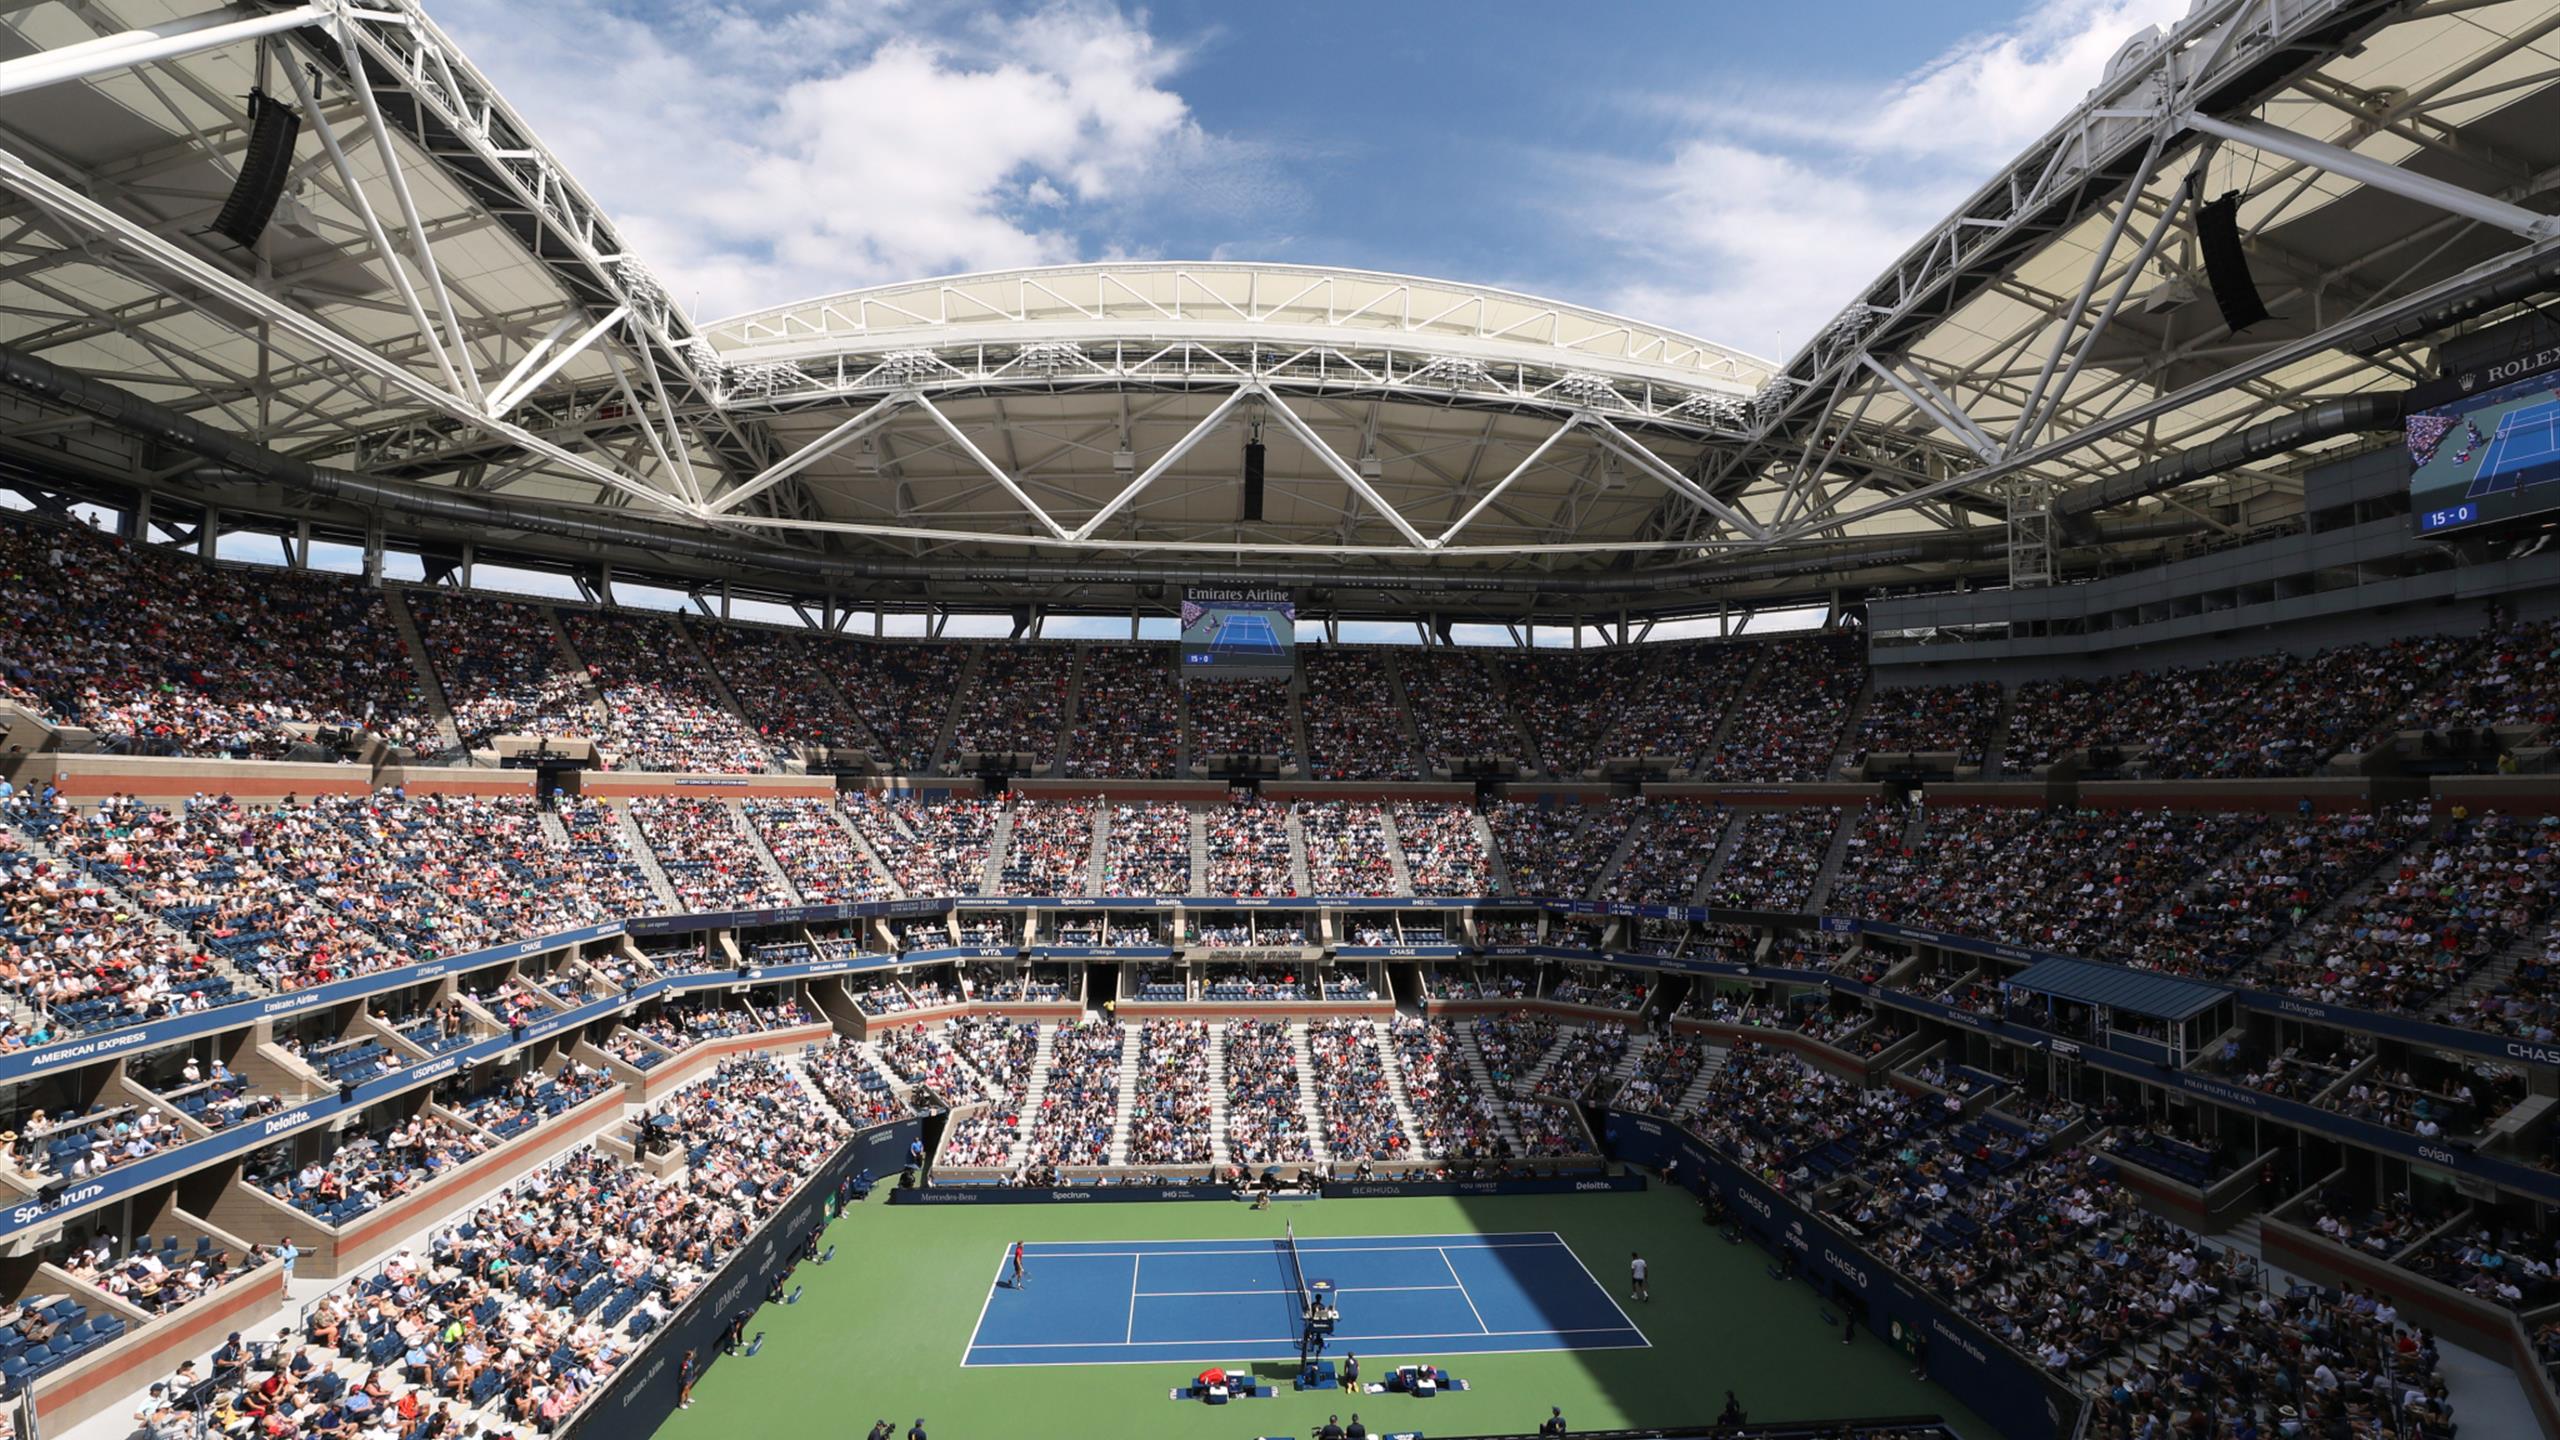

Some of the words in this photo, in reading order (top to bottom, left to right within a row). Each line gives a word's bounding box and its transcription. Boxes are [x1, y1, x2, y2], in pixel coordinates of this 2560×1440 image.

[2432, 511, 2446, 526] 15
[2458, 506, 2468, 521] 0
[1188, 588, 1243, 600] Emirates
[1246, 589, 1289, 601] Airline
[521, 940, 542, 953] CHASE
[979, 948, 1002, 956] WTA
[1389, 948, 1416, 956] CHASE
[264, 999, 296, 1013] Emirates
[295, 993, 319, 1006] Airline
[31, 1043, 95, 1066] AMERICAN
[97, 1031, 147, 1051] EXPRESS
[412, 1057, 456, 1080] USOPEN.ORG
[2203, 1083, 2227, 1097] RALPH
[2227, 1088, 2257, 1105] LAUREN
[265, 1111, 311, 1135] Deloitte.
[2418, 1145, 2454, 1165] evian
[1052, 1191, 1089, 1200] Spectrum
[1162, 1190, 1177, 1198] IHG
[1352, 1186, 1400, 1194] BERMUDA
[1576, 1181, 1611, 1190] Deloitte.
[13, 1184, 99, 1224] Spectrum
[921, 1193, 977, 1201] Mercedes-Benz
[1738, 1187, 1764, 1213] CHASE
[1824, 1248, 1857, 1282] CHASE
[1933, 1318, 1962, 1348] Emirates
[1962, 1339, 1987, 1364] Airline
